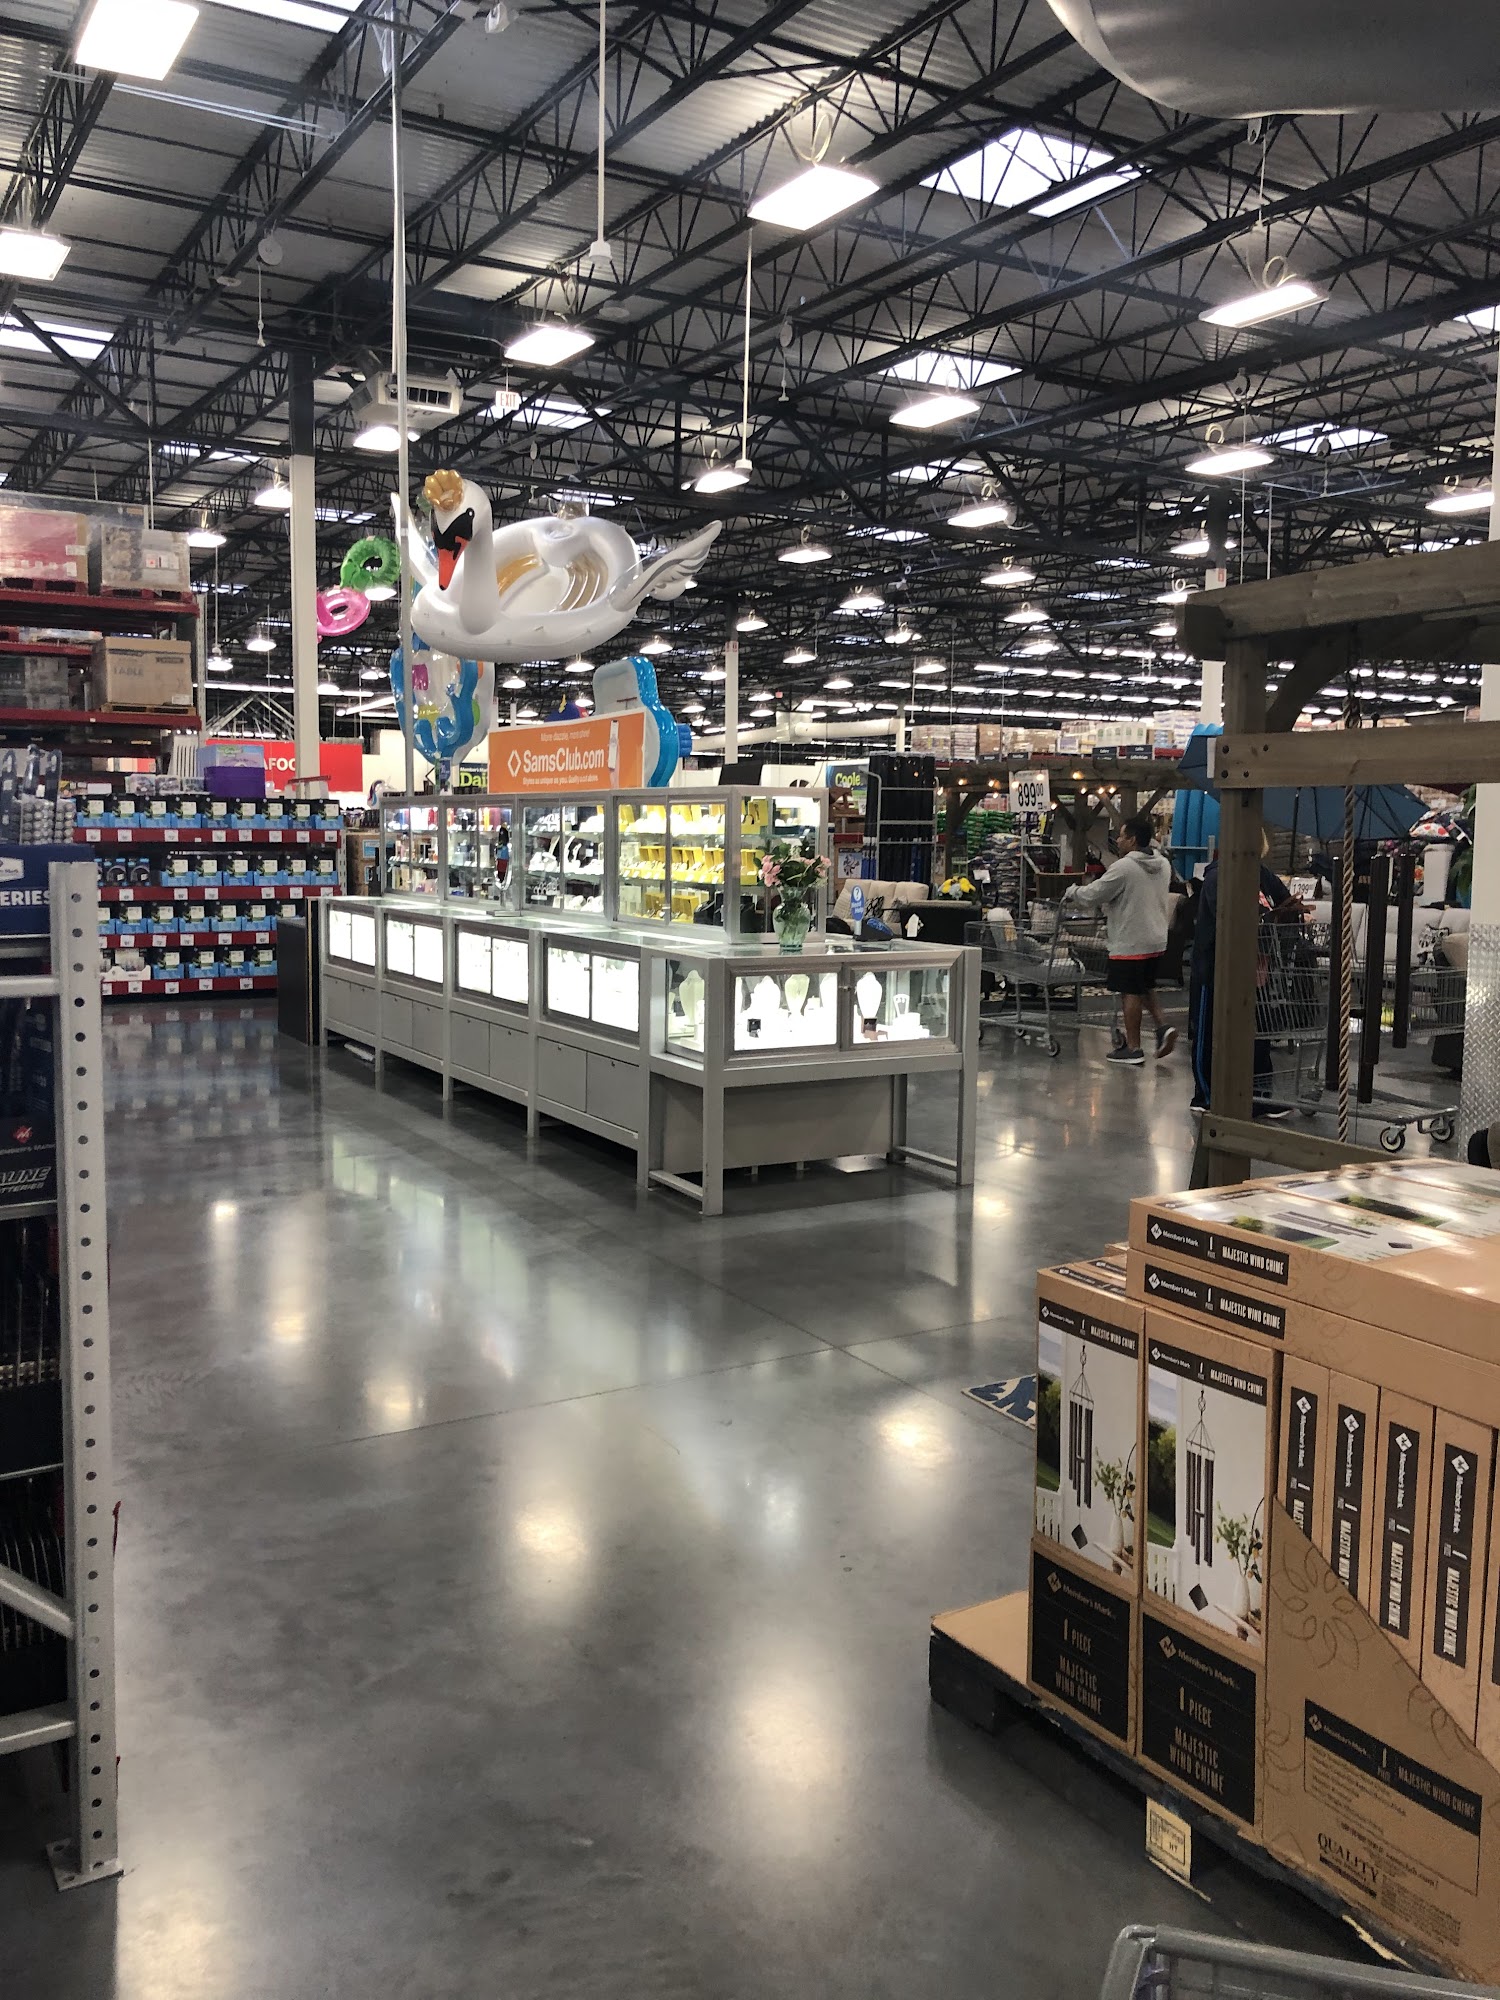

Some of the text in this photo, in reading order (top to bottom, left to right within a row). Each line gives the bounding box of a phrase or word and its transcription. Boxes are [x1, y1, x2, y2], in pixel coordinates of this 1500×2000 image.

[500, 392, 517, 408] EXIT
[523, 746, 605, 774] SamsClub.com
[460, 771, 487, 788] Dai
[835, 771, 863, 787] Coole
[1162, 1230, 1185, 1243] Member's
[1185, 1237, 1199, 1247] Mark
[1222, 1245, 1285, 1276] MAJESTIC WIND CHIME
[1160, 1280, 1184, 1294] Member's
[1184, 1288, 1197, 1298] Mark
[1219, 1298, 1281, 1330] MAJESTIC WIND CHIME
[1210, 1369, 1263, 1397] MAJESTIC WIND CHIME
[1071, 1629, 1092, 1656] PIECE
[1059, 1655, 1098, 1693] MAJESTIC
[1055, 1671, 1101, 1715] WIND CHIME
[1189, 1699, 1212, 1729] PIECE
[1174, 1726, 1219, 1769] MAJESTIC
[1169, 1744, 1224, 1796] WIND CHIME
[1317, 1832, 1379, 1883] QUALITY
